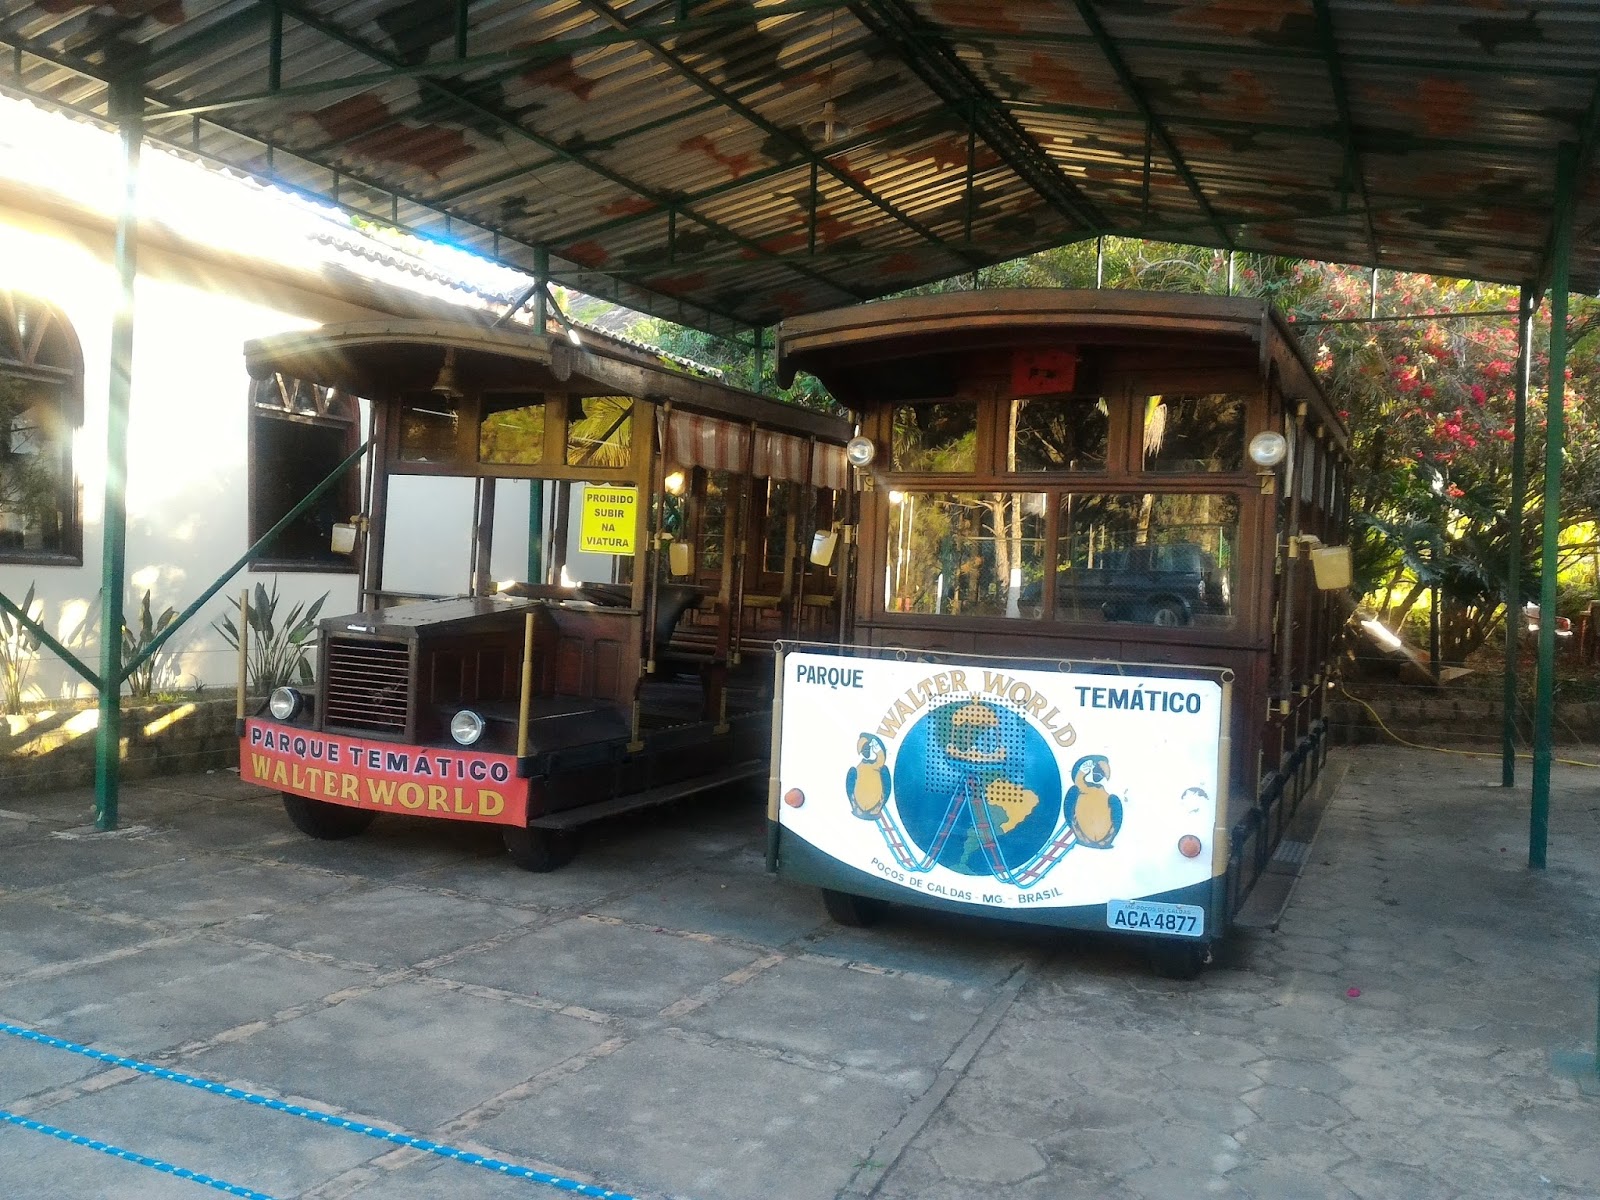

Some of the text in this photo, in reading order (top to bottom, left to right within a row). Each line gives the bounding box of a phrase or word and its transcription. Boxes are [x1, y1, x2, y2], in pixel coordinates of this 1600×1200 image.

[587, 494, 633, 504] PROIBIDO
[594, 508, 624, 518] SUBIR
[587, 537, 629, 547] VIATURA
[601, 523, 615, 532] NA
[797, 665, 1201, 714] PARQUE TEMÁTICO
[876, 669, 1077, 747] WALTER WORLD
[251, 727, 508, 782] PARQUE TEMÁTICO
[251, 752, 505, 817] WALTER WORLD
[870, 857, 905, 882] POÇOS
[909, 877, 923, 888] DE
[926, 882, 972, 901] CALDAS
[1018, 886, 1064, 904] BRASIL
